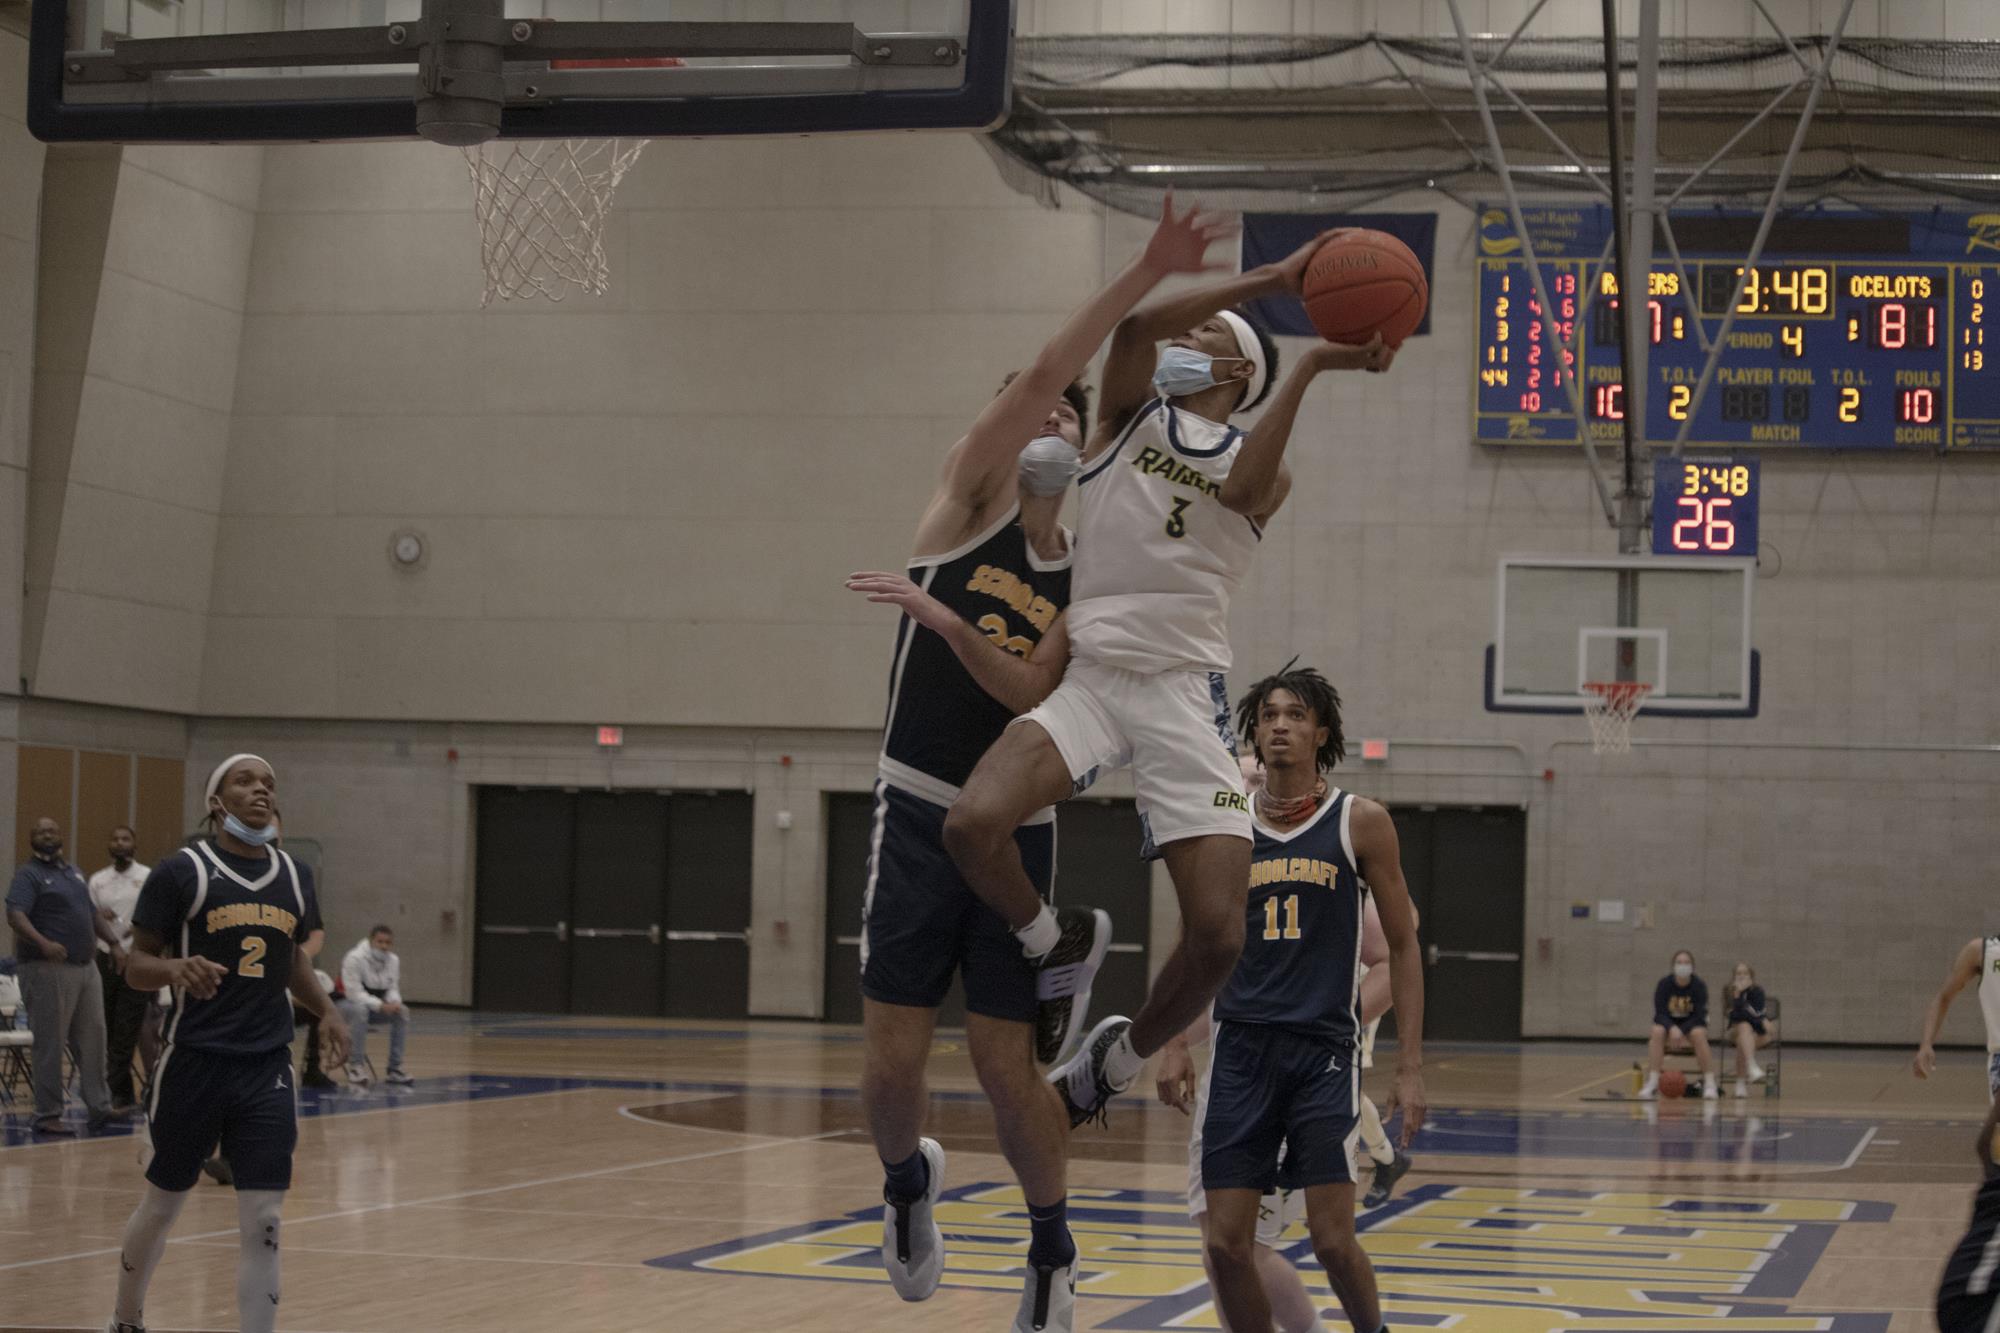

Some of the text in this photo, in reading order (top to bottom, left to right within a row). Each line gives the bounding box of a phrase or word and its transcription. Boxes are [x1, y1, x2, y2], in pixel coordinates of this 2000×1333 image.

[1556, 272, 1575, 294] 13
[1736, 268, 1827, 314] 3:48
[1850, 275, 1931, 299] OCELOTS
[1971, 279, 1983, 299] 0
[1496, 296, 1509, 318] 2
[1971, 303, 1983, 323] 2
[1528, 320, 1541, 341] 2
[1881, 303, 1934, 348] 81
[1782, 326, 1802, 356] 4
[1528, 344, 1541, 365] 2
[1964, 350, 1983, 370] 13
[1481, 368, 1508, 387] 44
[1528, 368, 1541, 389] 2
[1718, 368, 1815, 385] PLAYER FOUL
[1895, 369, 1941, 386] FOULS
[1520, 391, 1541, 412] 10
[1669, 384, 1690, 420] 2
[1839, 387, 1860, 422] 2
[1904, 388, 1933, 423] 10
[1751, 425, 1800, 441] MATCH
[1895, 427, 1941, 443] SCORE
[1131, 446, 1221, 499] RAIDER
[1684, 464, 1749, 496] 3:48
[1166, 496, 1192, 538] 3
[1673, 497, 1735, 550] 26
[1250, 857, 1339, 890] HOOLCRAFT
[1263, 894, 1301, 940] 11
[238, 936, 267, 978] 2
